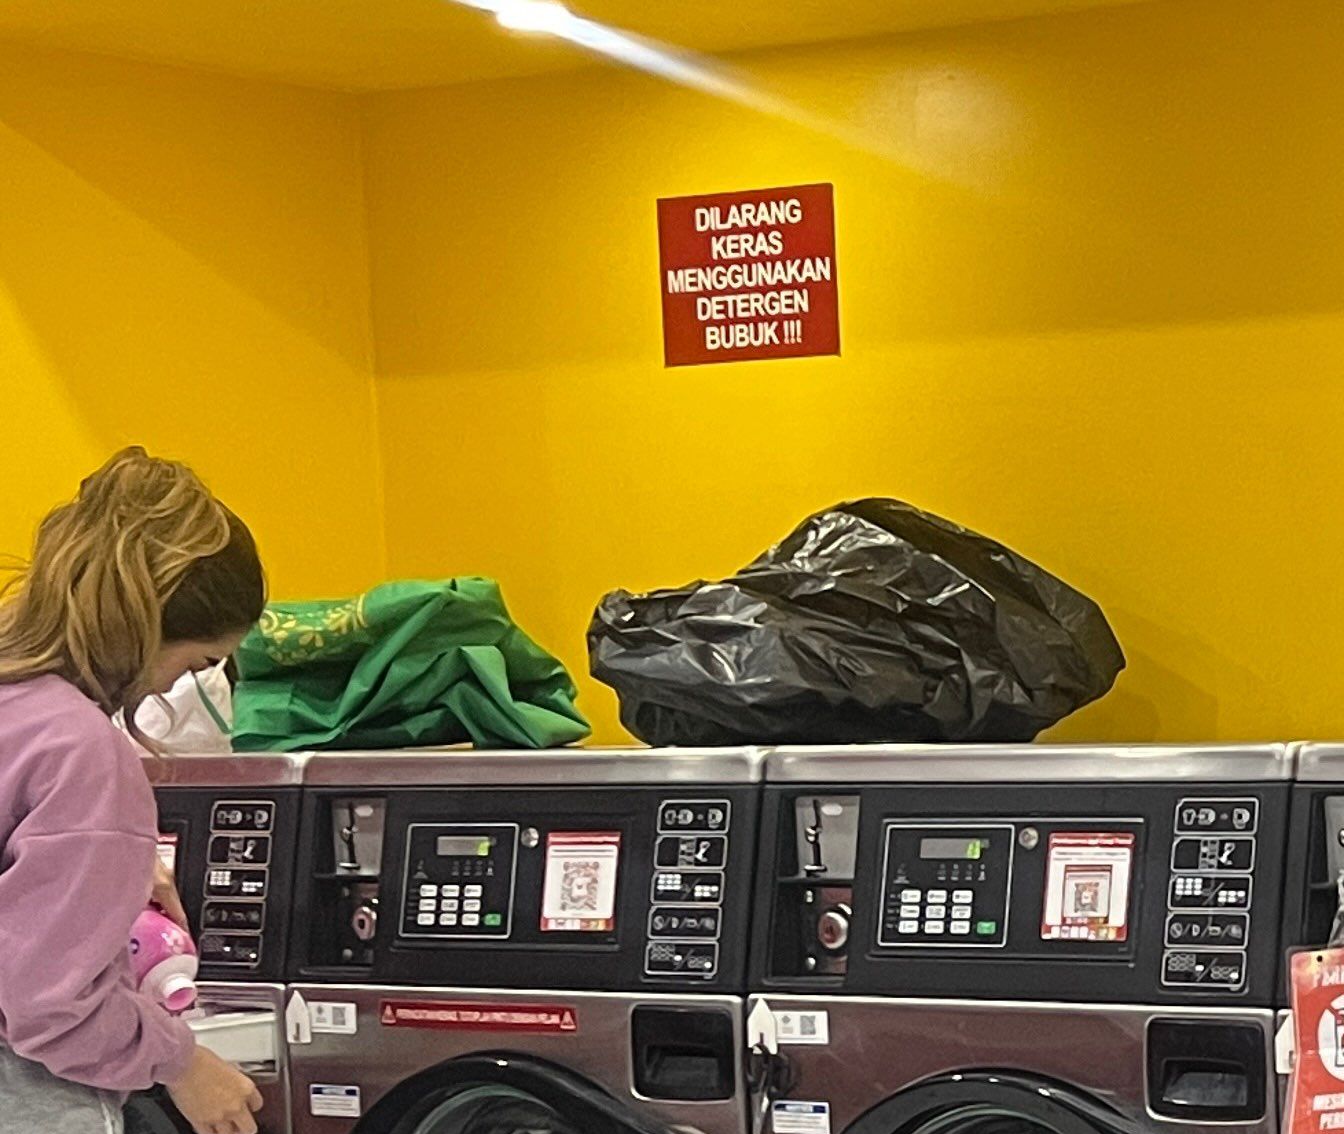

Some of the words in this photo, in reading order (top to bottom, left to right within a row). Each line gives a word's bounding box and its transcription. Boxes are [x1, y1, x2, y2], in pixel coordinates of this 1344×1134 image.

[695, 199, 802, 232] DILARANG
[711, 231, 783, 260] KERAS
[667, 257, 831, 293] MENGGUNAKAN
[696, 289, 808, 321] DETERGEN
[705, 321, 779, 350] BUBUK
[783, 319, 802, 344] !!!
